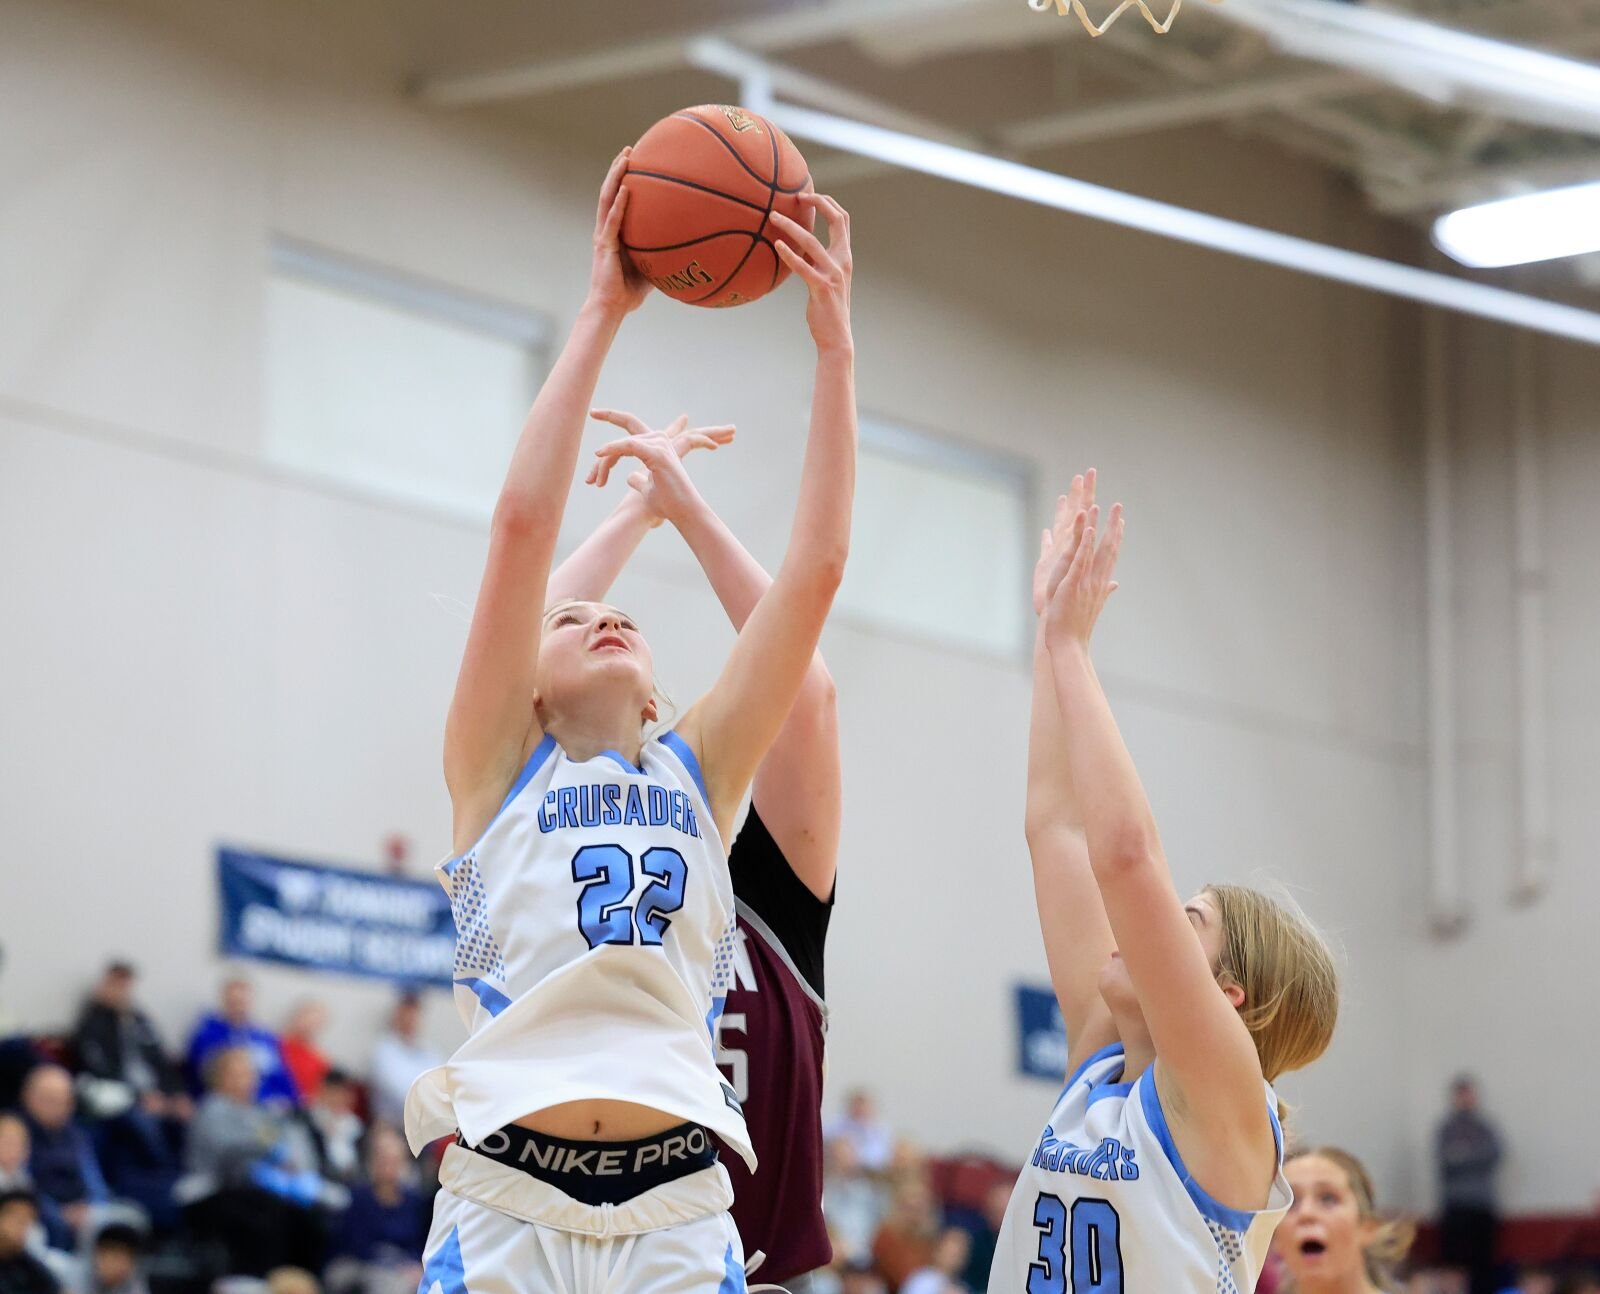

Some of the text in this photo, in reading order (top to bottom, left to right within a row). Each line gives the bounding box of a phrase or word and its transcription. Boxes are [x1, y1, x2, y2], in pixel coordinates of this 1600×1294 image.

[537, 784, 703, 840] CRUSADER
[571, 844, 688, 951] 22
[518, 1139, 628, 1176] NIKE
[633, 1128, 705, 1173] PRO
[1025, 1191, 1125, 1294] 30
